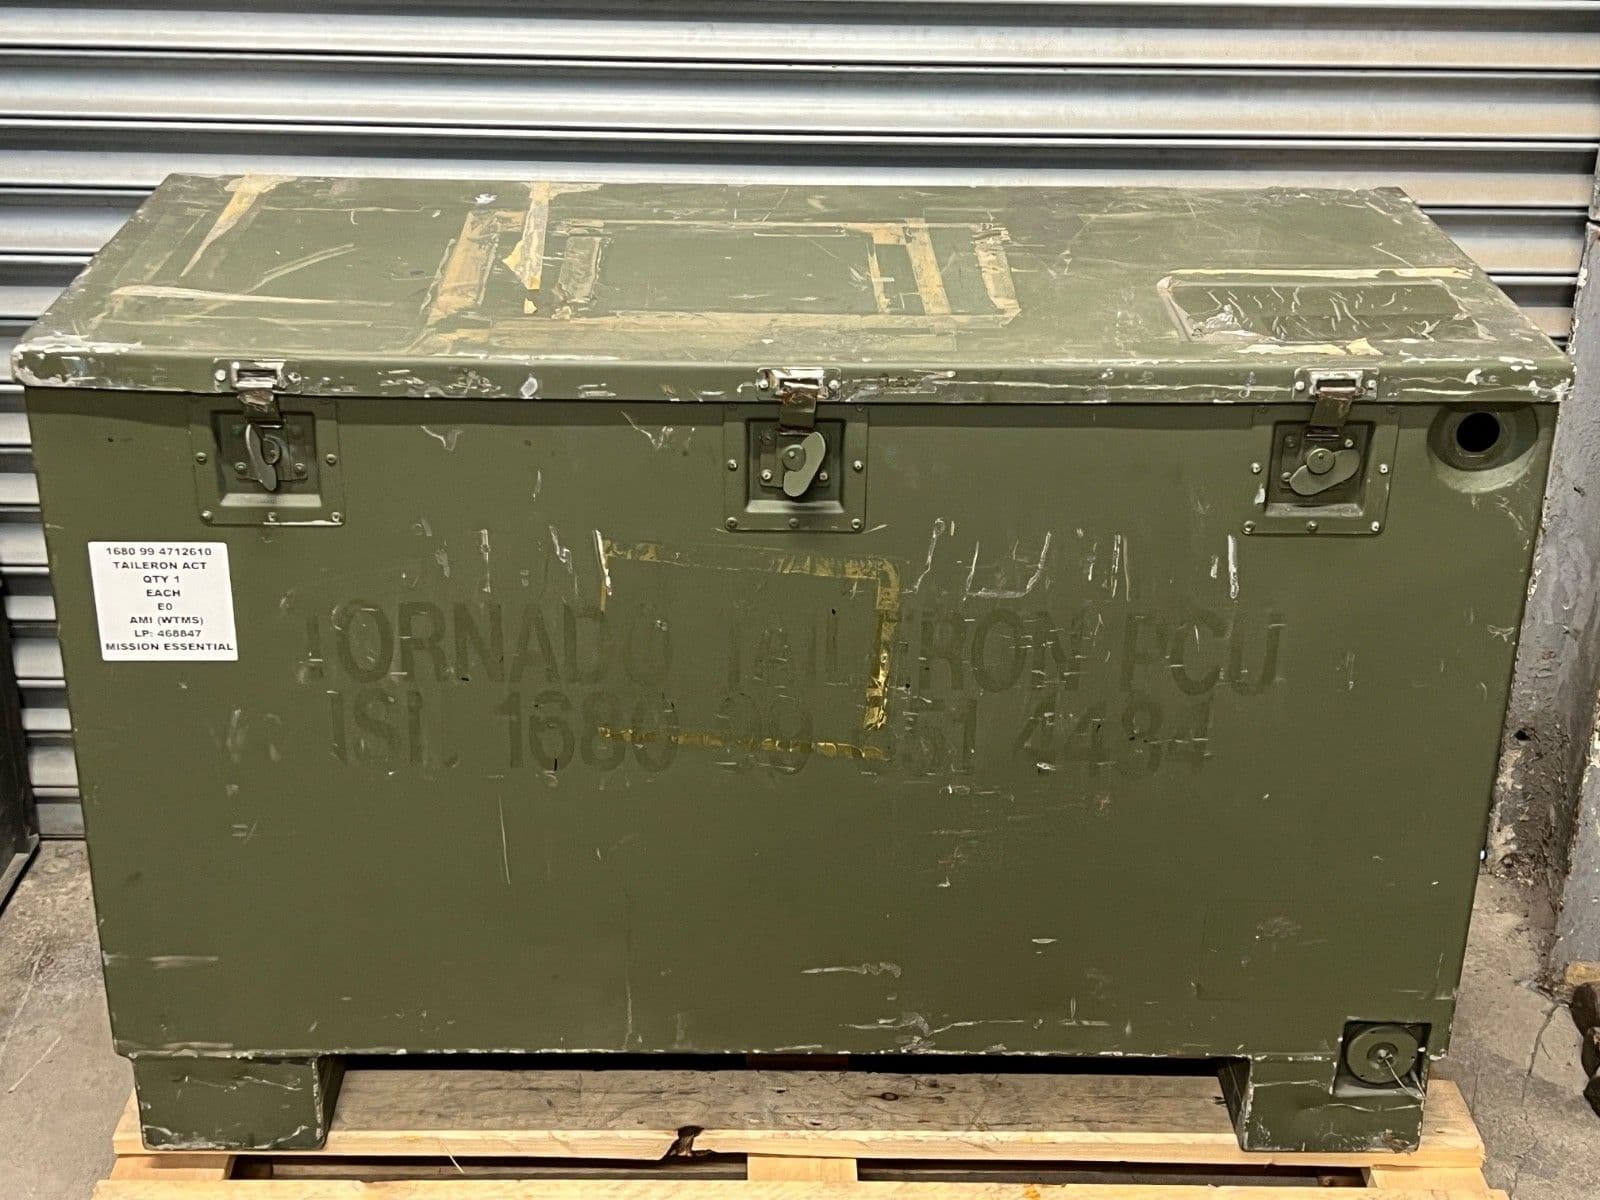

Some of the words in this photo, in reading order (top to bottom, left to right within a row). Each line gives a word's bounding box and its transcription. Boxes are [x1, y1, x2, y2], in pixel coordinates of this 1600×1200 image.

[106, 547, 136, 556] 1680
[139, 547, 155, 556] 99
[158, 547, 212, 556] 4712610
[112, 561, 178, 570] TAILERON
[182, 561, 208, 570] ACT
[143, 575, 169, 583] QTY
[173, 575, 180, 583] 1
[146, 589, 181, 597] EACH
[129, 616, 153, 624] AMI
[157, 616, 204, 626] (WTMS)
[134, 629, 154, 638] LP:
[157, 629, 202, 638] 468847
[105, 642, 159, 651] MISSION
[163, 642, 234, 651] ESSENTIAL
[1119, 606, 1287, 697] PCU
[494, 689, 681, 774] 1680
